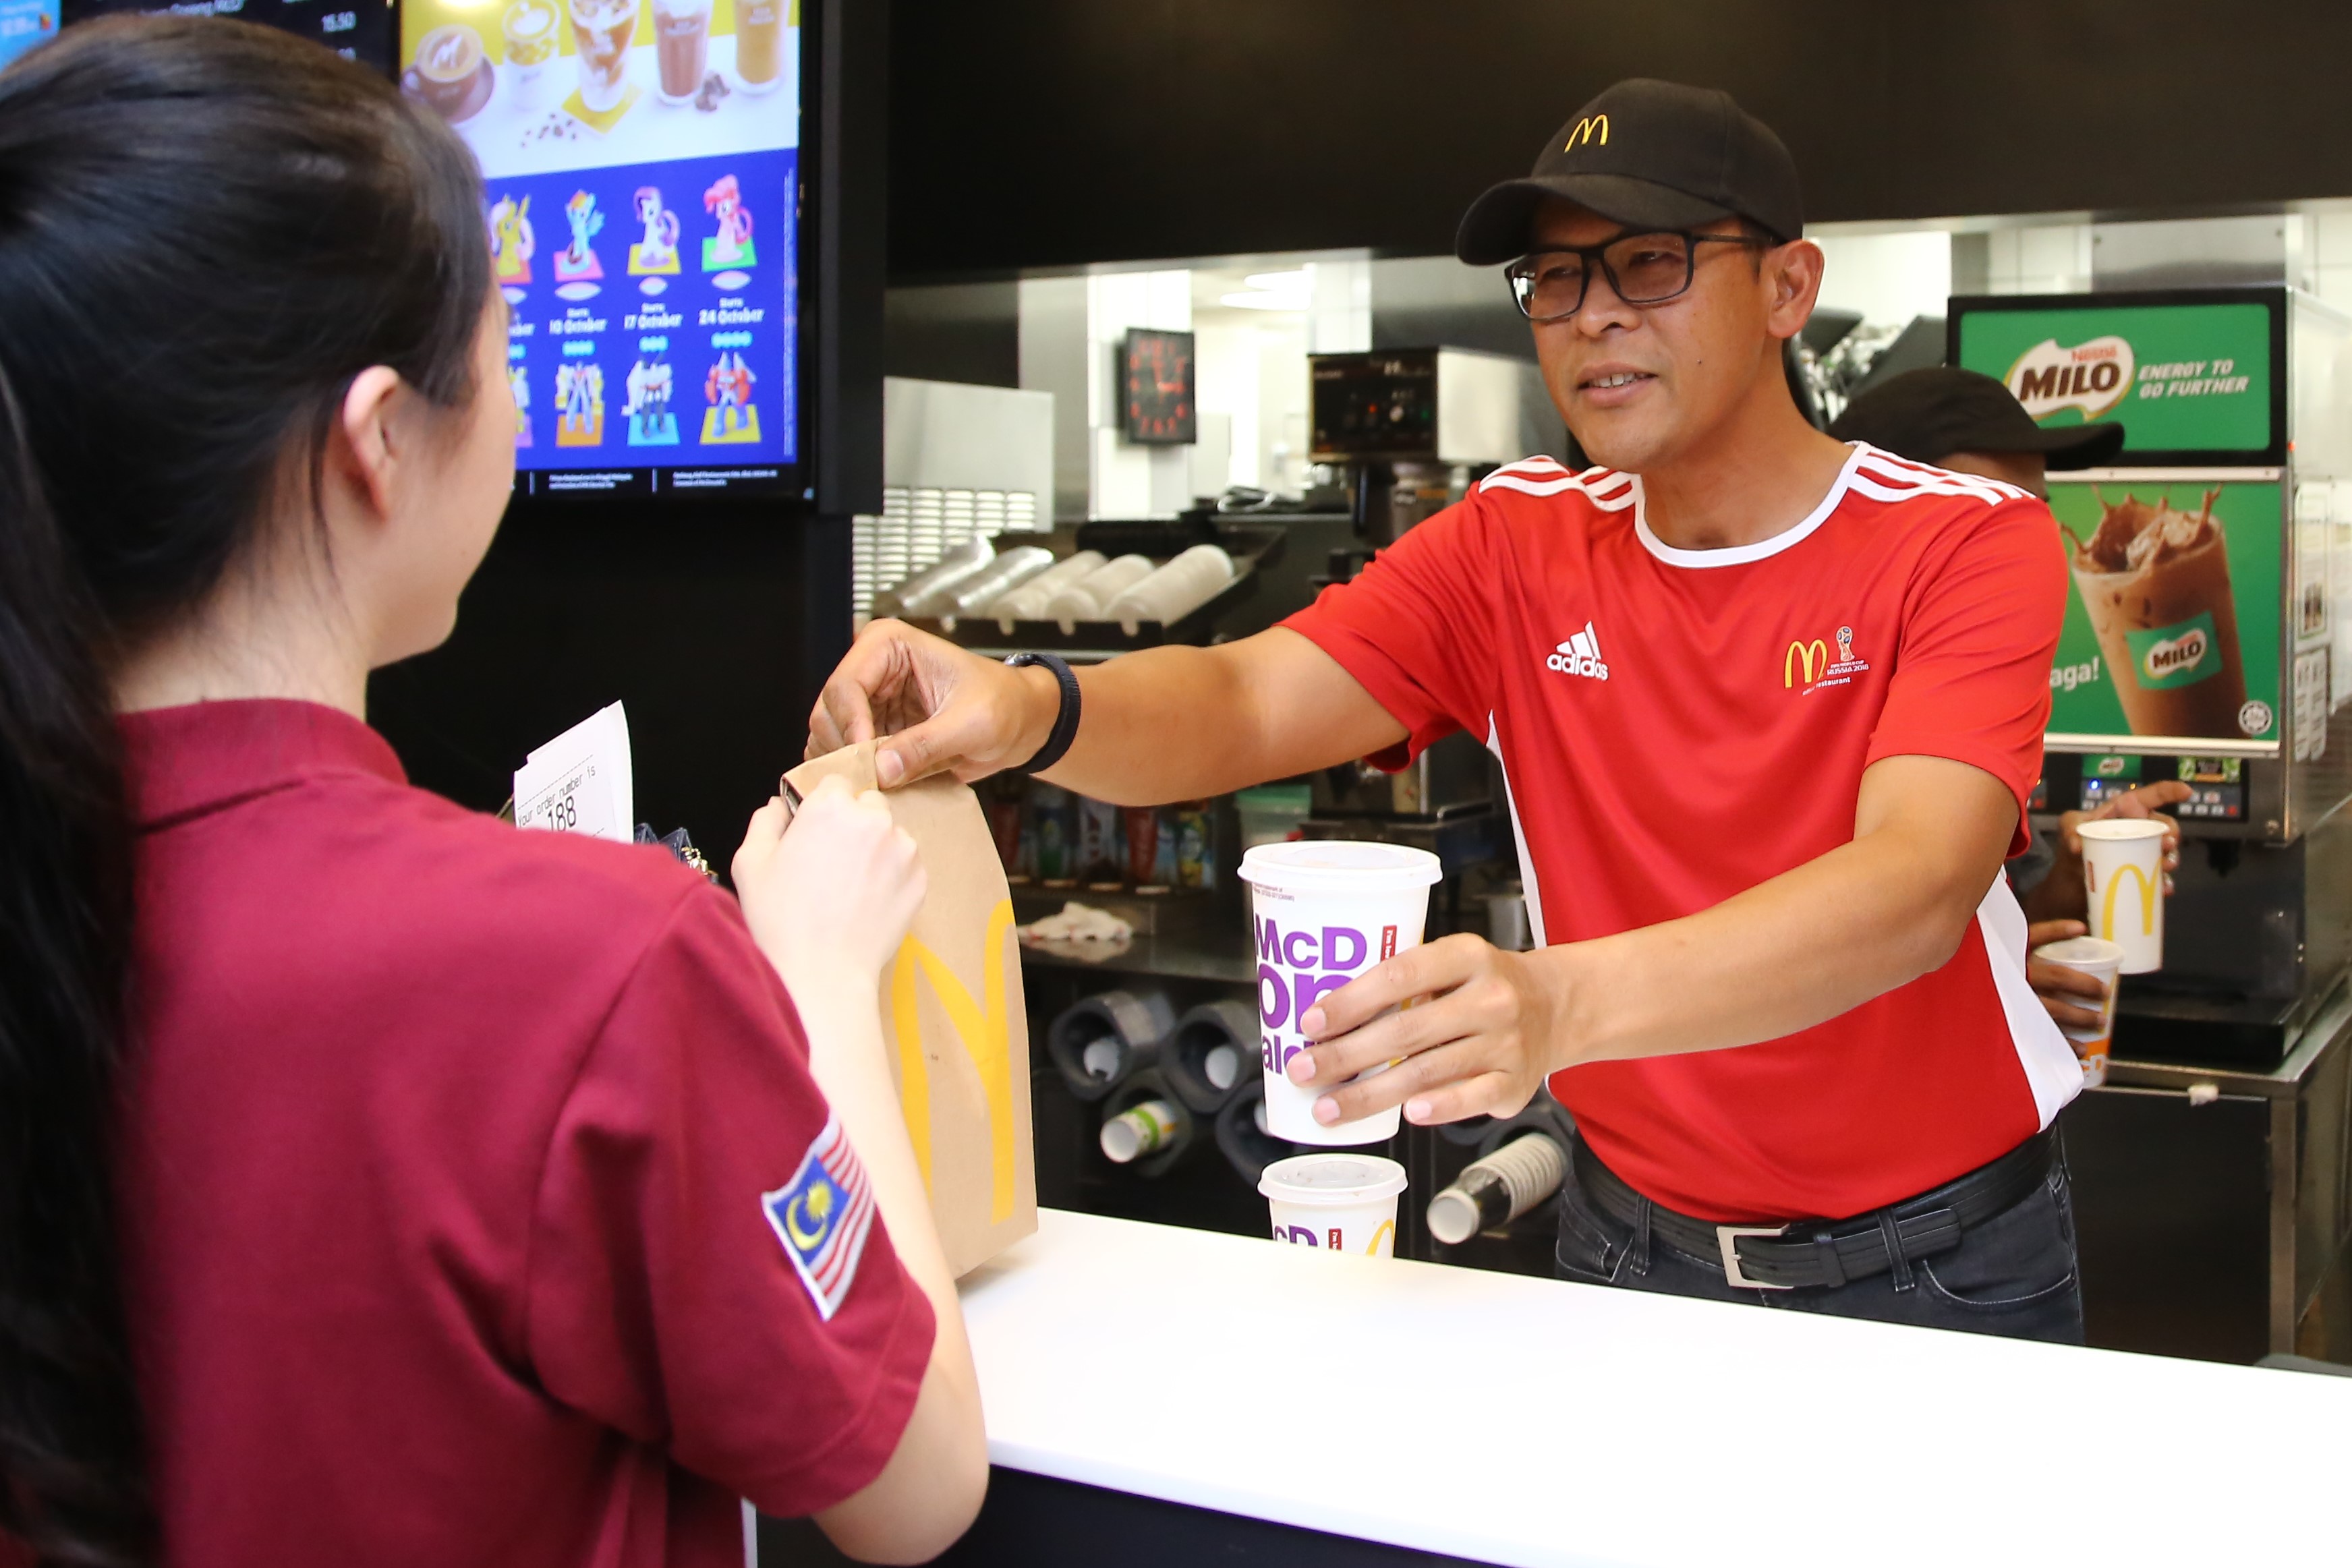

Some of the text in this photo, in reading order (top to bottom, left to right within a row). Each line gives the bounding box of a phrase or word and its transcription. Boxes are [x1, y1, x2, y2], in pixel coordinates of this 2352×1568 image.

[321, 11, 356, 32] 15.50
[564, 316, 607, 335] October
[623, 312, 683, 330] 17 October
[698, 306, 765, 326] 24 October
[2019, 362, 2119, 401] MILO
[2138, 359, 2235, 381] ENERGY TO
[2140, 376, 2249, 399] GO FURTHER
[2153, 643, 2200, 668] MILO
[1545, 653, 1609, 682] adidas
[1827, 664, 1870, 676] RUSSIA 2018
[2050, 656, 2100, 692] aga!
[1816, 676, 1851, 689] restaurant
[518, 765, 596, 828] Your order number is
[547, 795, 577, 832] 188
[1255, 913, 1367, 971] McD
